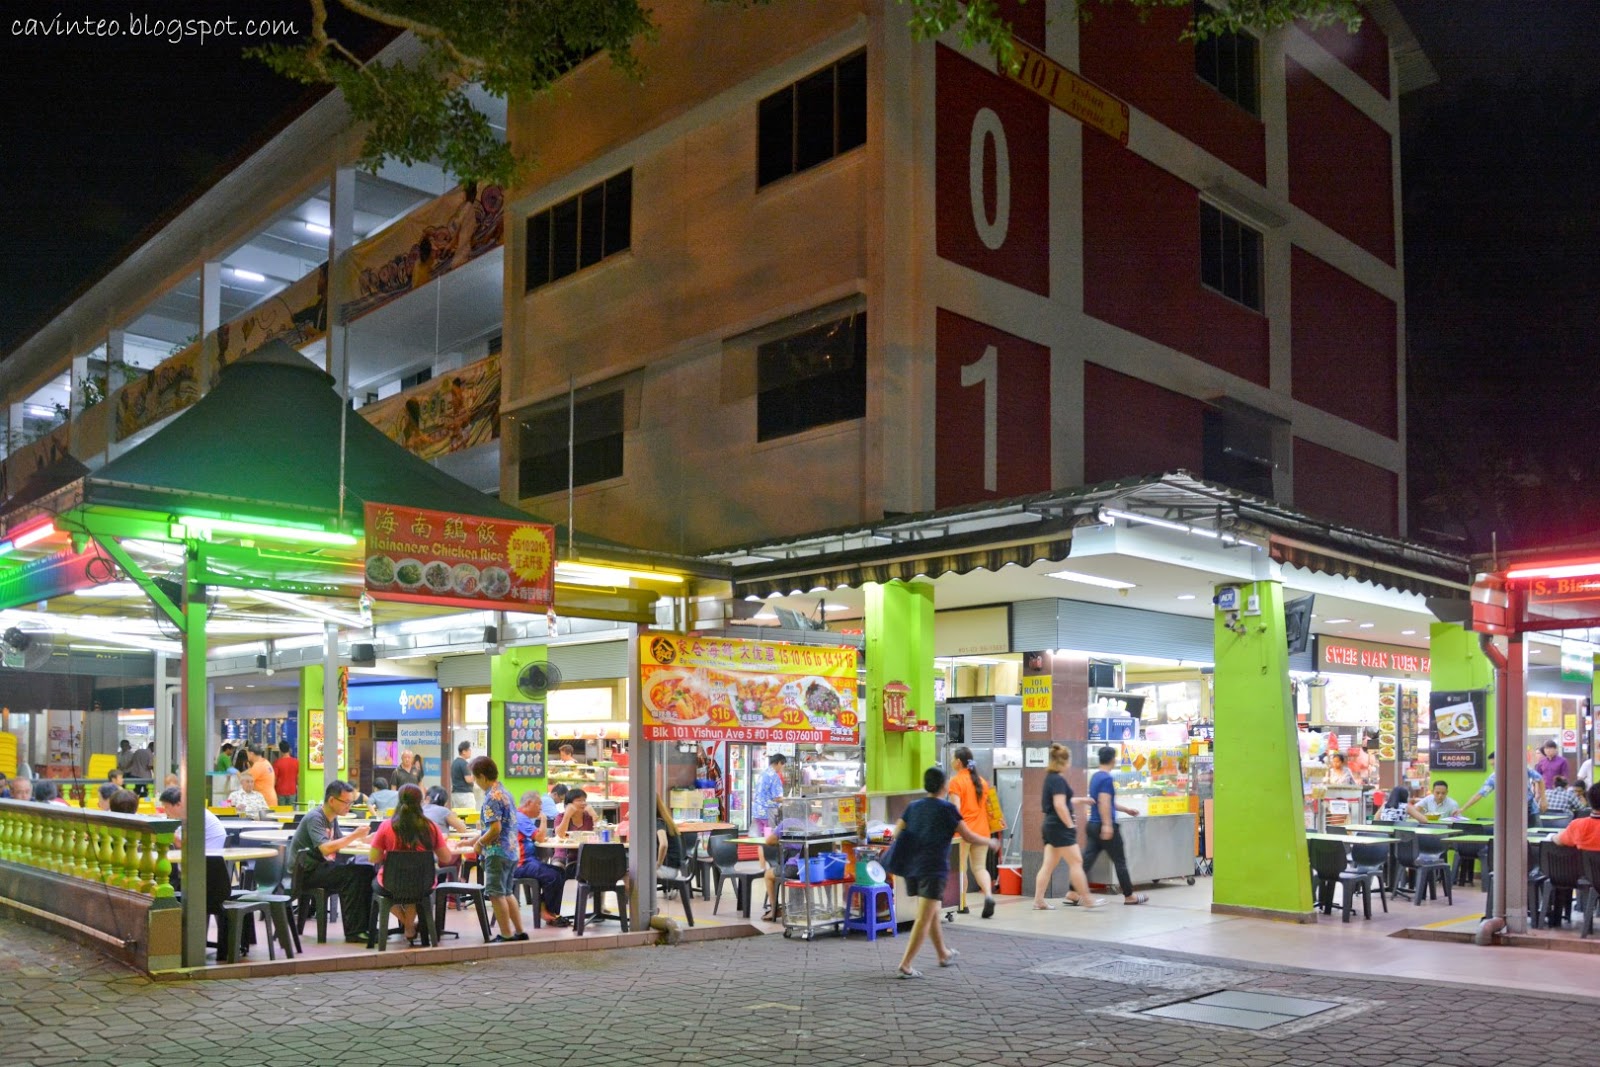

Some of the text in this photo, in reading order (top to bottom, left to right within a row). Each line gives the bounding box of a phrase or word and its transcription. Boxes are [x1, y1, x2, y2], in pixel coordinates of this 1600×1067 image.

[1018, 52, 1061, 98] 101
[370, 535, 504, 562] Hainanese Chicken Rice
[1535, 580, 1552, 596] S.
[779, 649, 789, 664] 15
[791, 650, 801, 666] 10
[802, 651, 812, 666] 16
[814, 652, 822, 666] to
[1325, 645, 1359, 665] SWEE
[1361, 649, 1389, 668] SIAN
[1024, 686, 1050, 695] ROJAK
[407, 693, 434, 710] POSB
[711, 707, 731, 720] $16
[783, 710, 801, 723] $12
[841, 713, 855, 725] $12
[652, 726, 824, 741] Blk 101 Yishun Ave 5 #01-03 (S)760101
